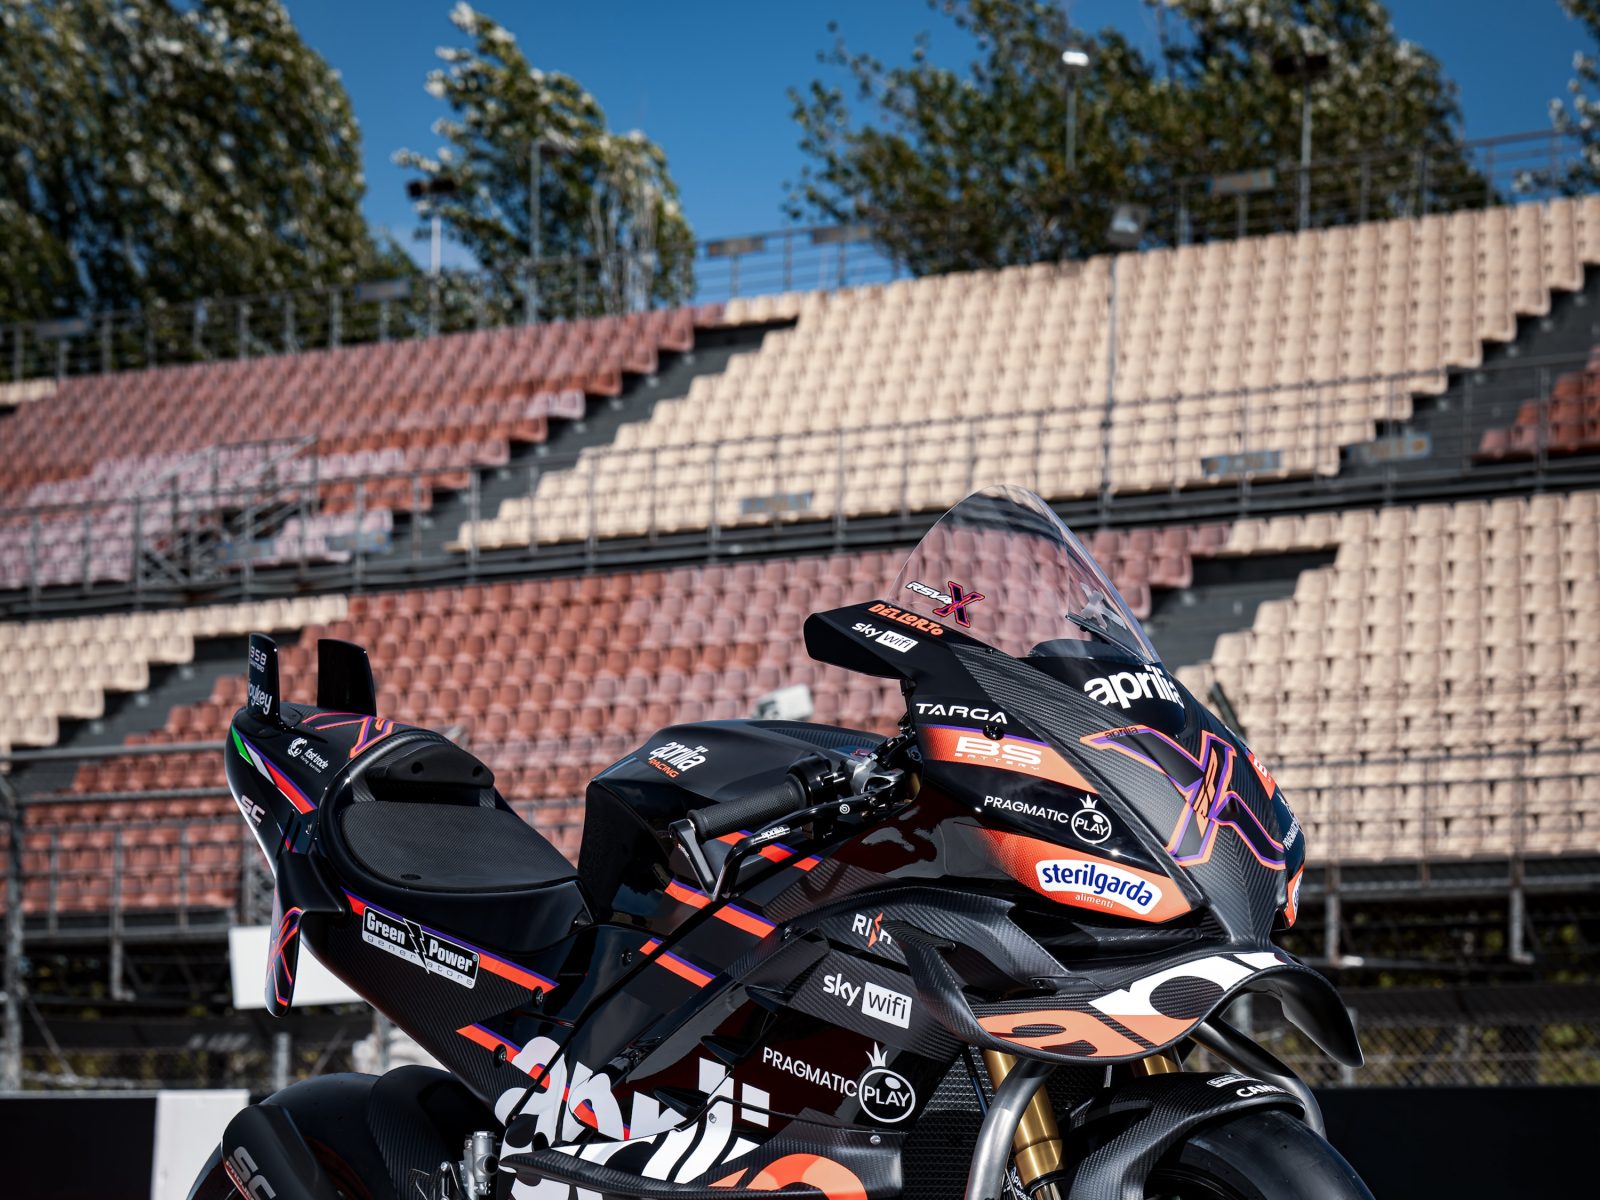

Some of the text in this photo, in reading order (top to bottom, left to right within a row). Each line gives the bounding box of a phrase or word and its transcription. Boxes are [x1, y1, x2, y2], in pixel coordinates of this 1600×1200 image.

[868, 603, 943, 636] DELLORTO
[852, 622, 914, 649] sky wifi
[1084, 664, 1185, 709] aprilia
[916, 703, 1008, 724] TARGA
[1104, 725, 1138, 739] aprilia
[648, 741, 709, 772] aprilia
[956, 736, 1042, 765] BS
[648, 758, 680, 778] RACING
[241, 795, 265, 824] SC
[984, 796, 1109, 836] PRAGMATIC PLAY
[1042, 864, 1153, 907] sterilgarda
[1075, 893, 1114, 909] alimenti
[366, 911, 473, 972] Green Power
[823, 973, 908, 1020] sky wifi
[762, 1046, 911, 1107] PRAGMATIC PLAY
